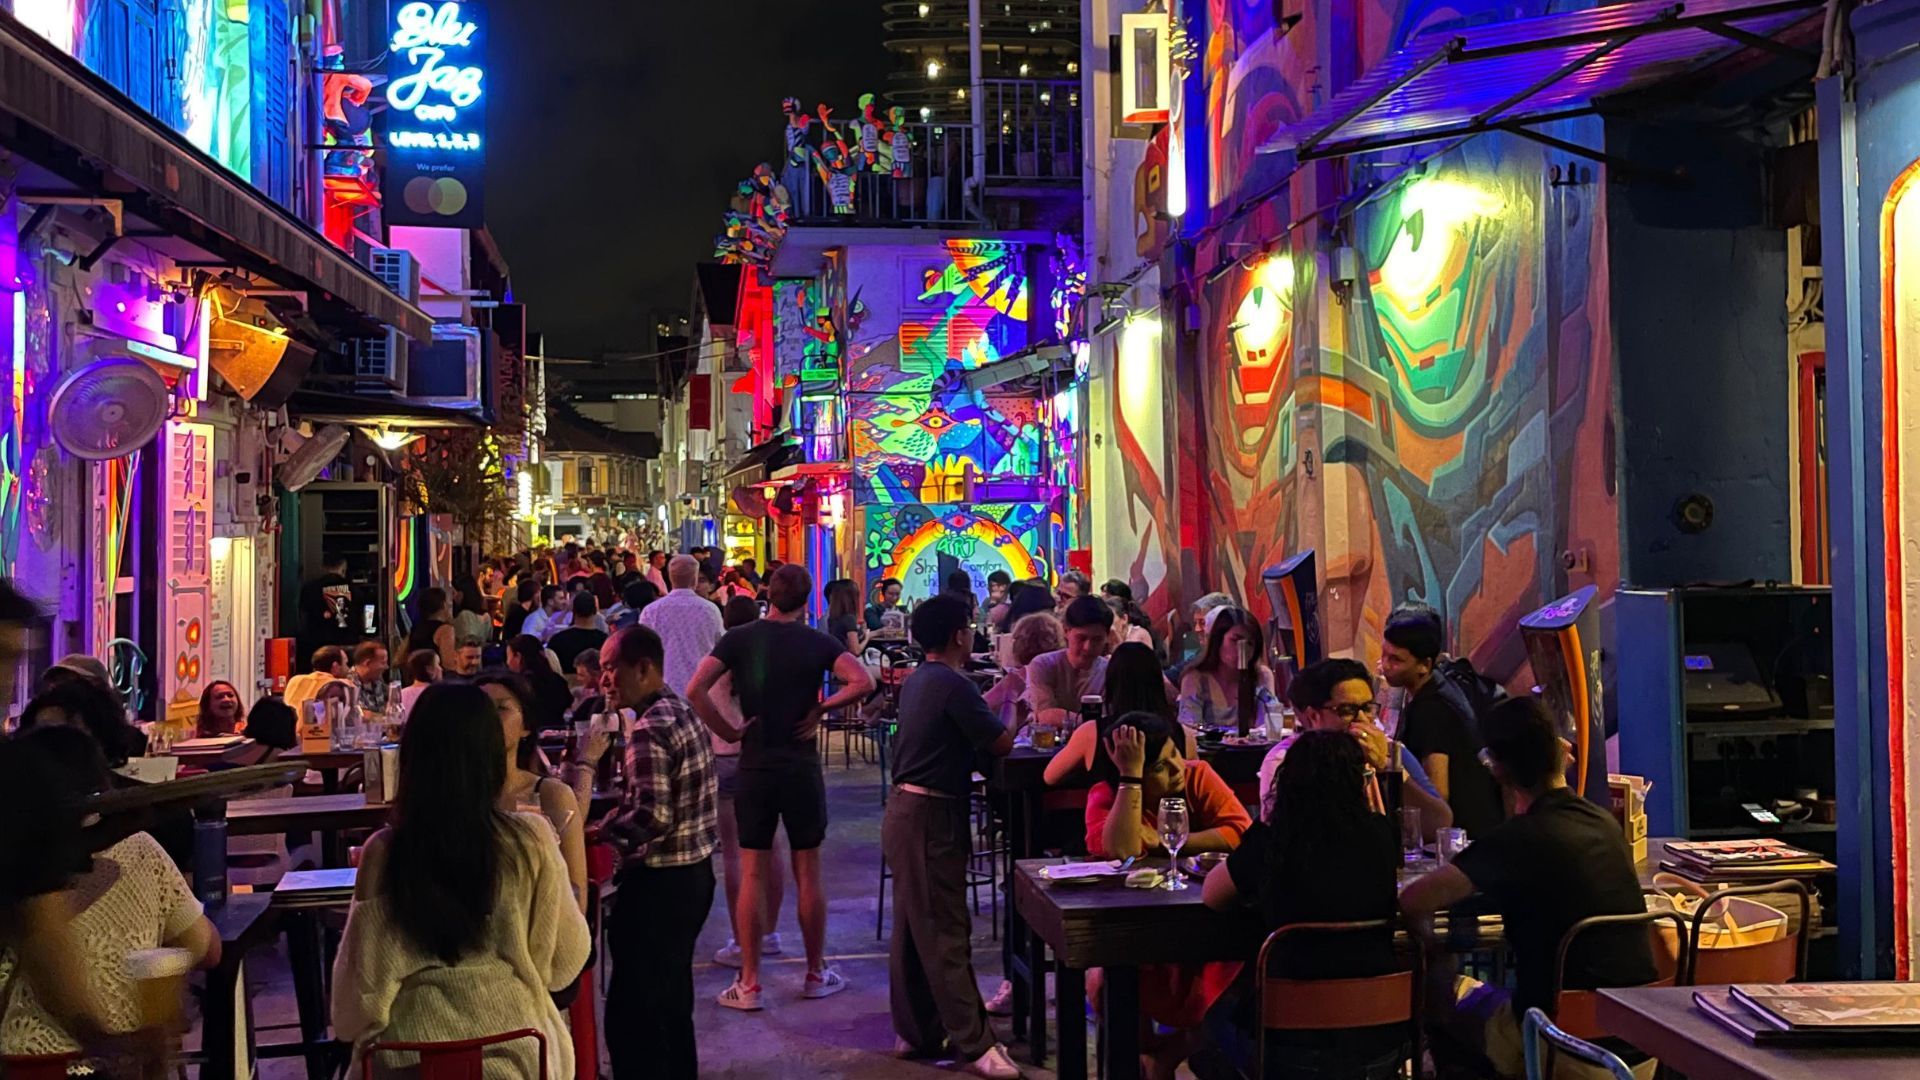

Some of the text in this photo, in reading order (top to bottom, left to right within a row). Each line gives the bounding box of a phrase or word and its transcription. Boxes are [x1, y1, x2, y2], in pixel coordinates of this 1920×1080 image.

[390, 2, 477, 51] Blu
[417, 163, 455, 173] We prefer
[923, 574, 937, 587] th
